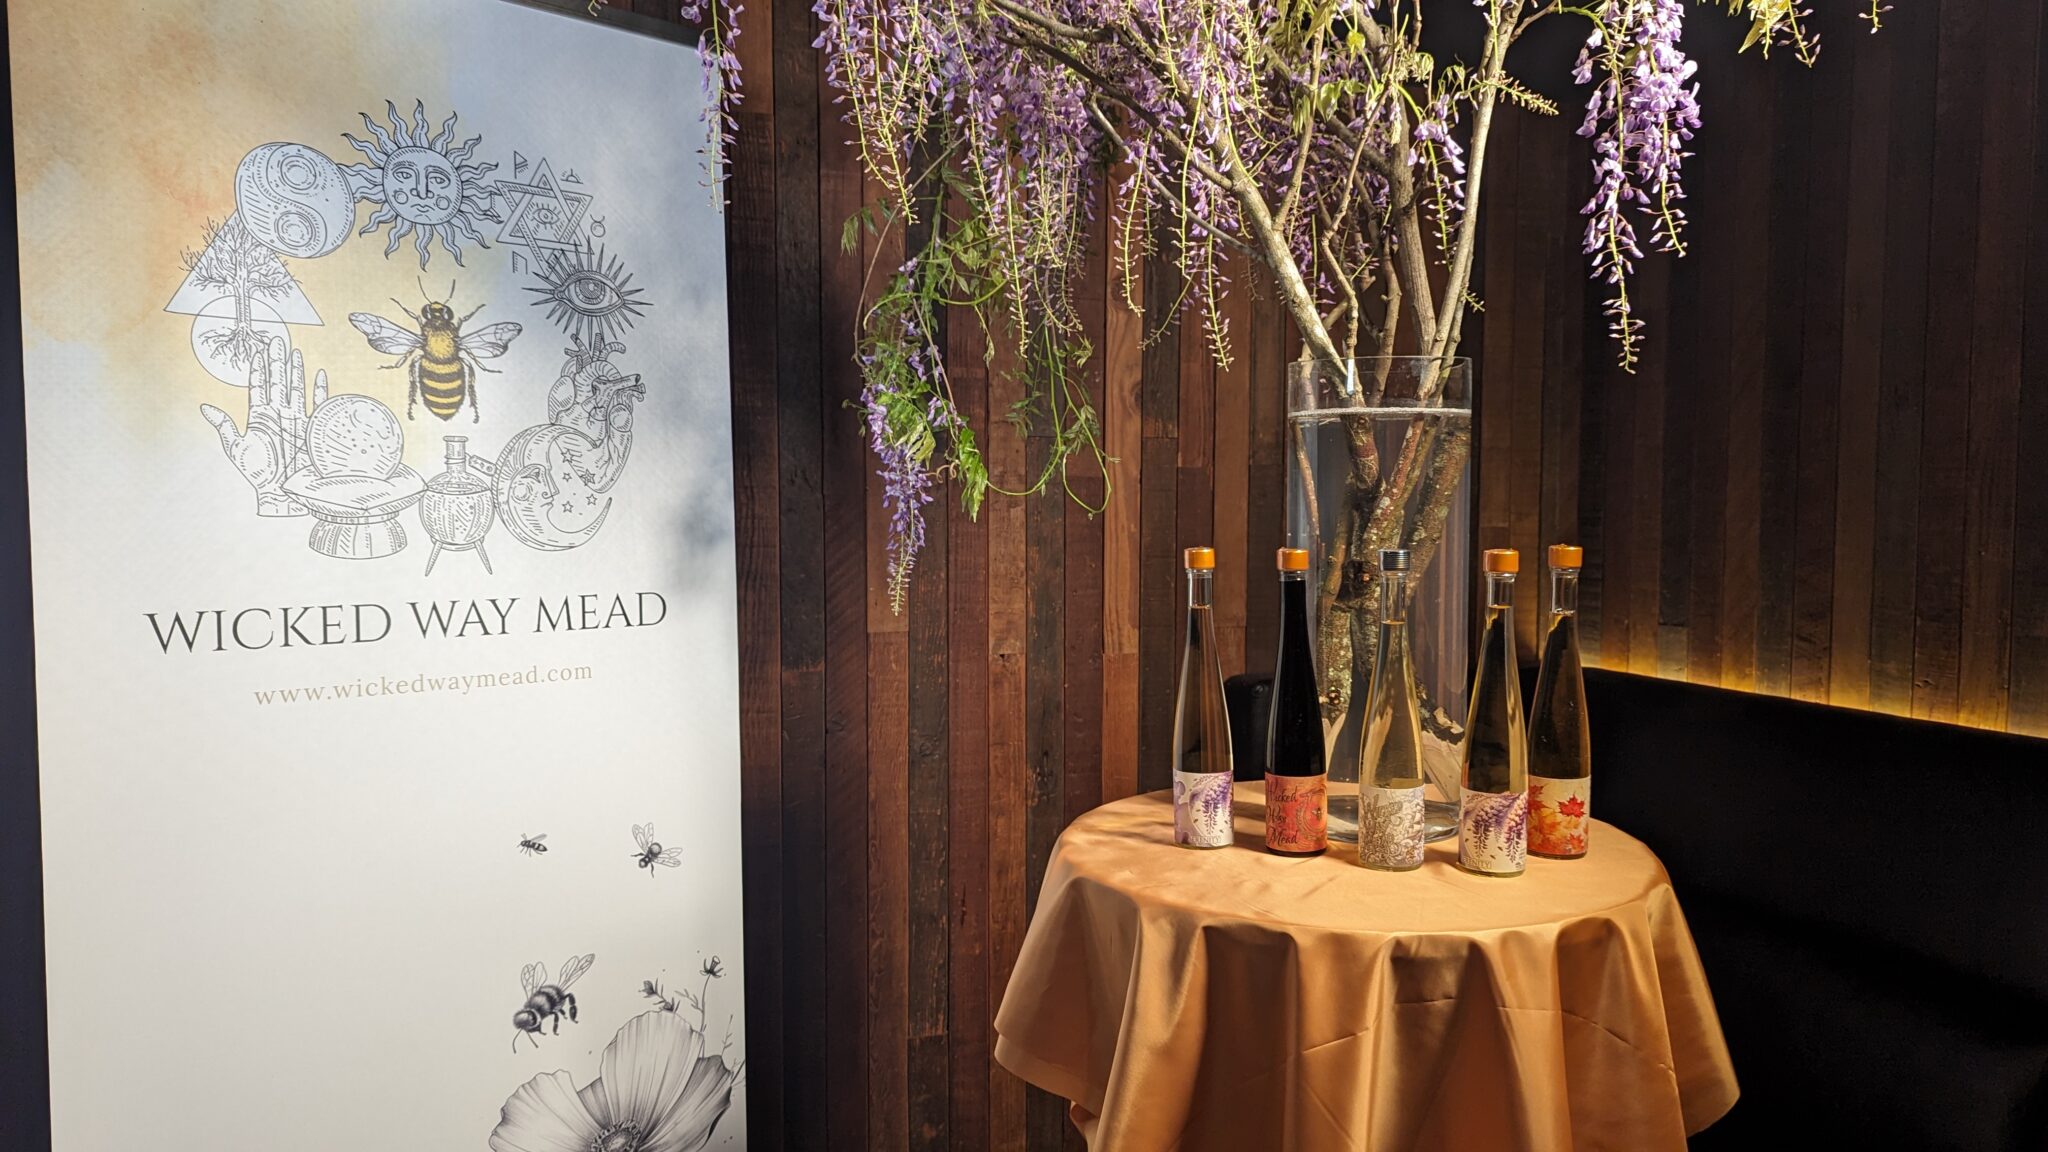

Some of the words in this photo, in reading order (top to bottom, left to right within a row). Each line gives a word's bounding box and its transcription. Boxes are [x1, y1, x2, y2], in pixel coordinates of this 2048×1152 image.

[142, 603, 392, 655] WICKED
[406, 598, 520, 639] WAY
[532, 591, 667, 633] MEAD
[254, 665, 593, 706] www.wickedwaymead.com
[1268, 827, 1298, 846] Mead
